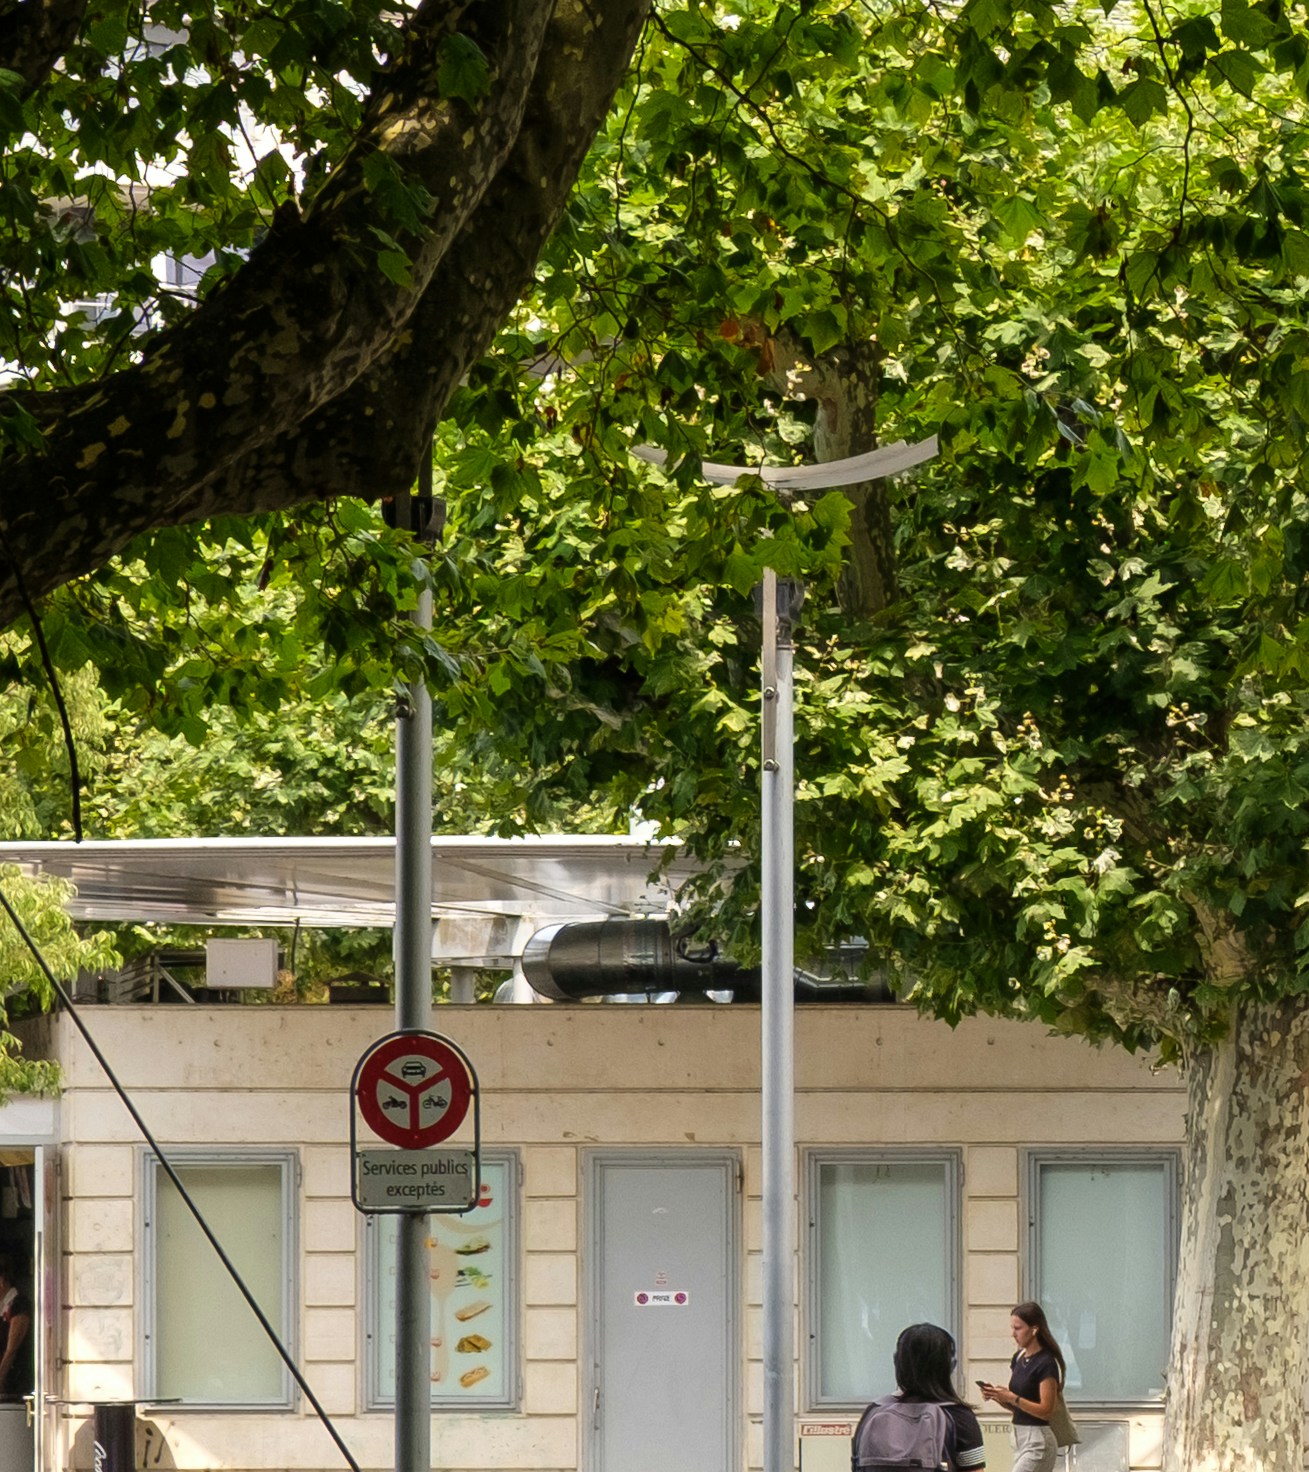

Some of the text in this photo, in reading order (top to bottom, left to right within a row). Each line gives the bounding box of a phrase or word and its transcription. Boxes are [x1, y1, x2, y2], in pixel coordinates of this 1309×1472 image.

[363, 1159, 469, 1179] Services publics
[386, 1180, 446, 1201] exceptés
